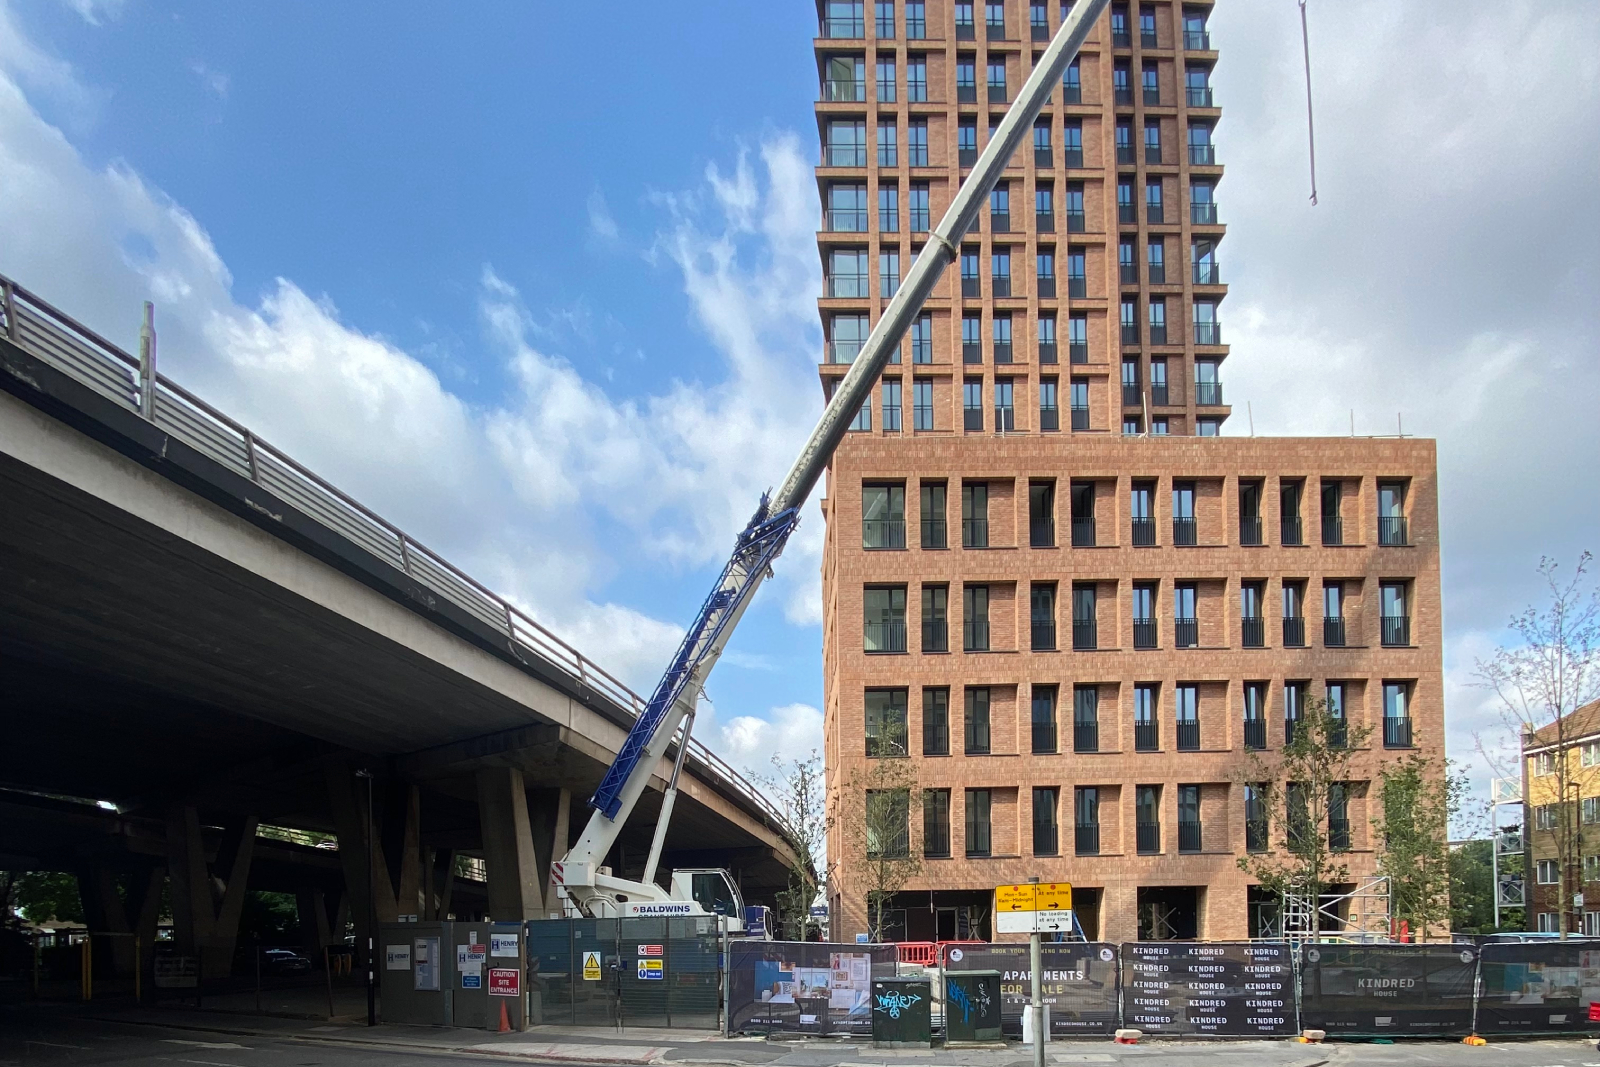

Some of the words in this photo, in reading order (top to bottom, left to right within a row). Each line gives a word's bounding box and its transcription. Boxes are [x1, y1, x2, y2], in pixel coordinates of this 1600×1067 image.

[491, 940, 499, 950] H
[459, 953, 466, 963] H
[1003, 970, 1084, 980] APARMENTS
[1358, 978, 1415, 988] KINDRED
[1000, 984, 1023, 994] FOR
[1040, 984, 1064, 994] ALE
